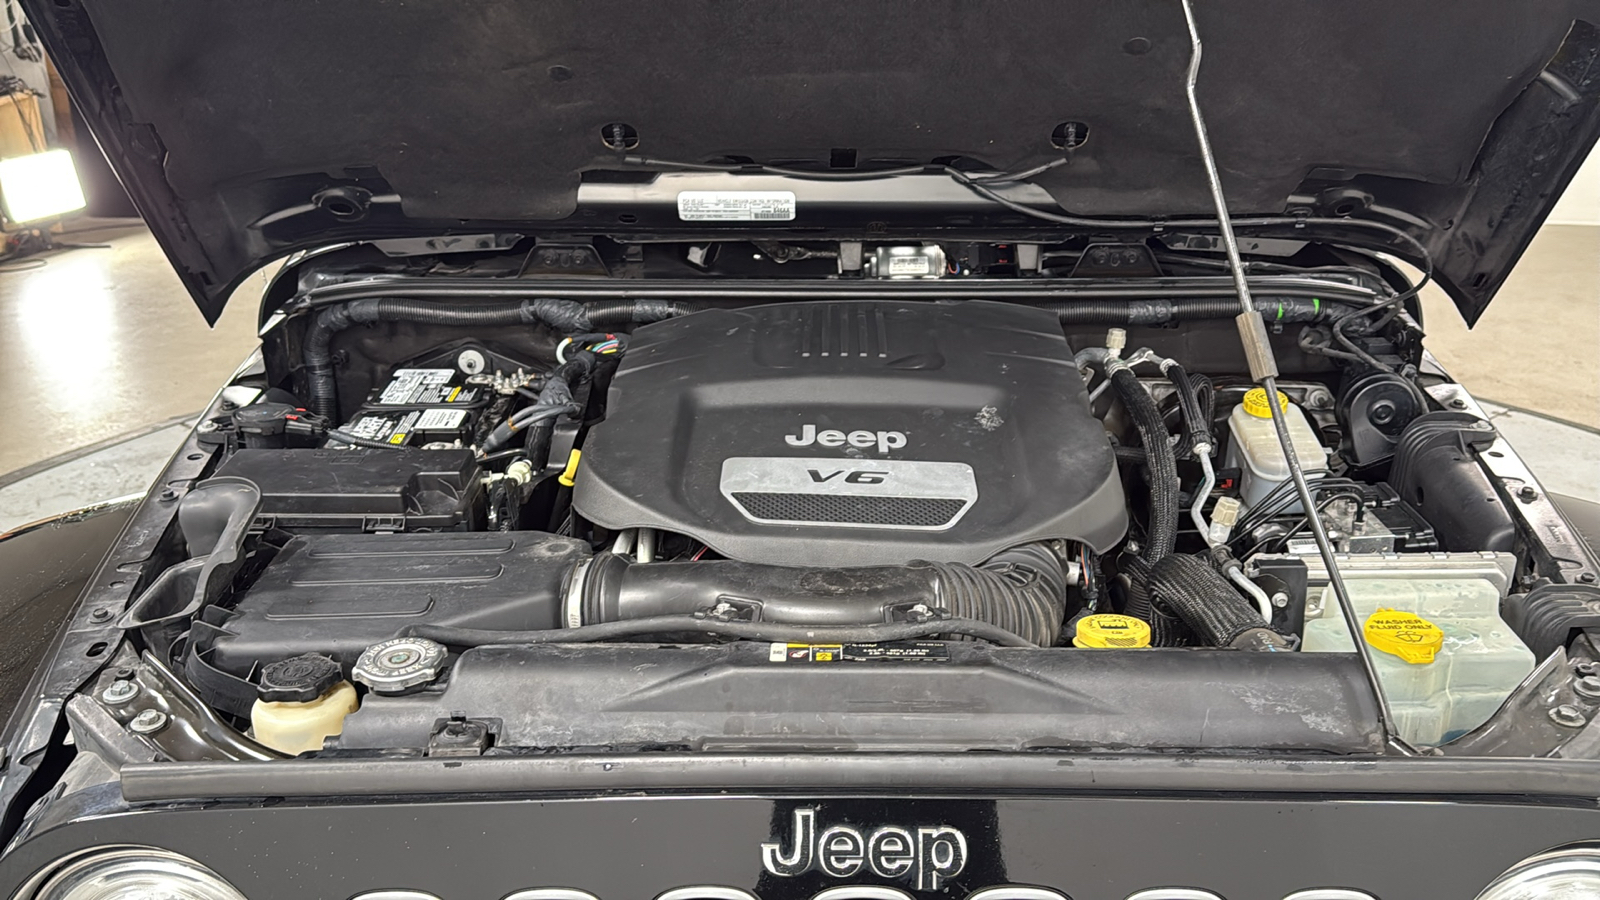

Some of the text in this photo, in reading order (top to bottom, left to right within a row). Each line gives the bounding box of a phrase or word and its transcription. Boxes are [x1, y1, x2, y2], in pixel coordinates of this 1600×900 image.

[785, 424, 908, 453] Jeep
[807, 469, 889, 485] V6
[761, 808, 968, 891] Jeep
